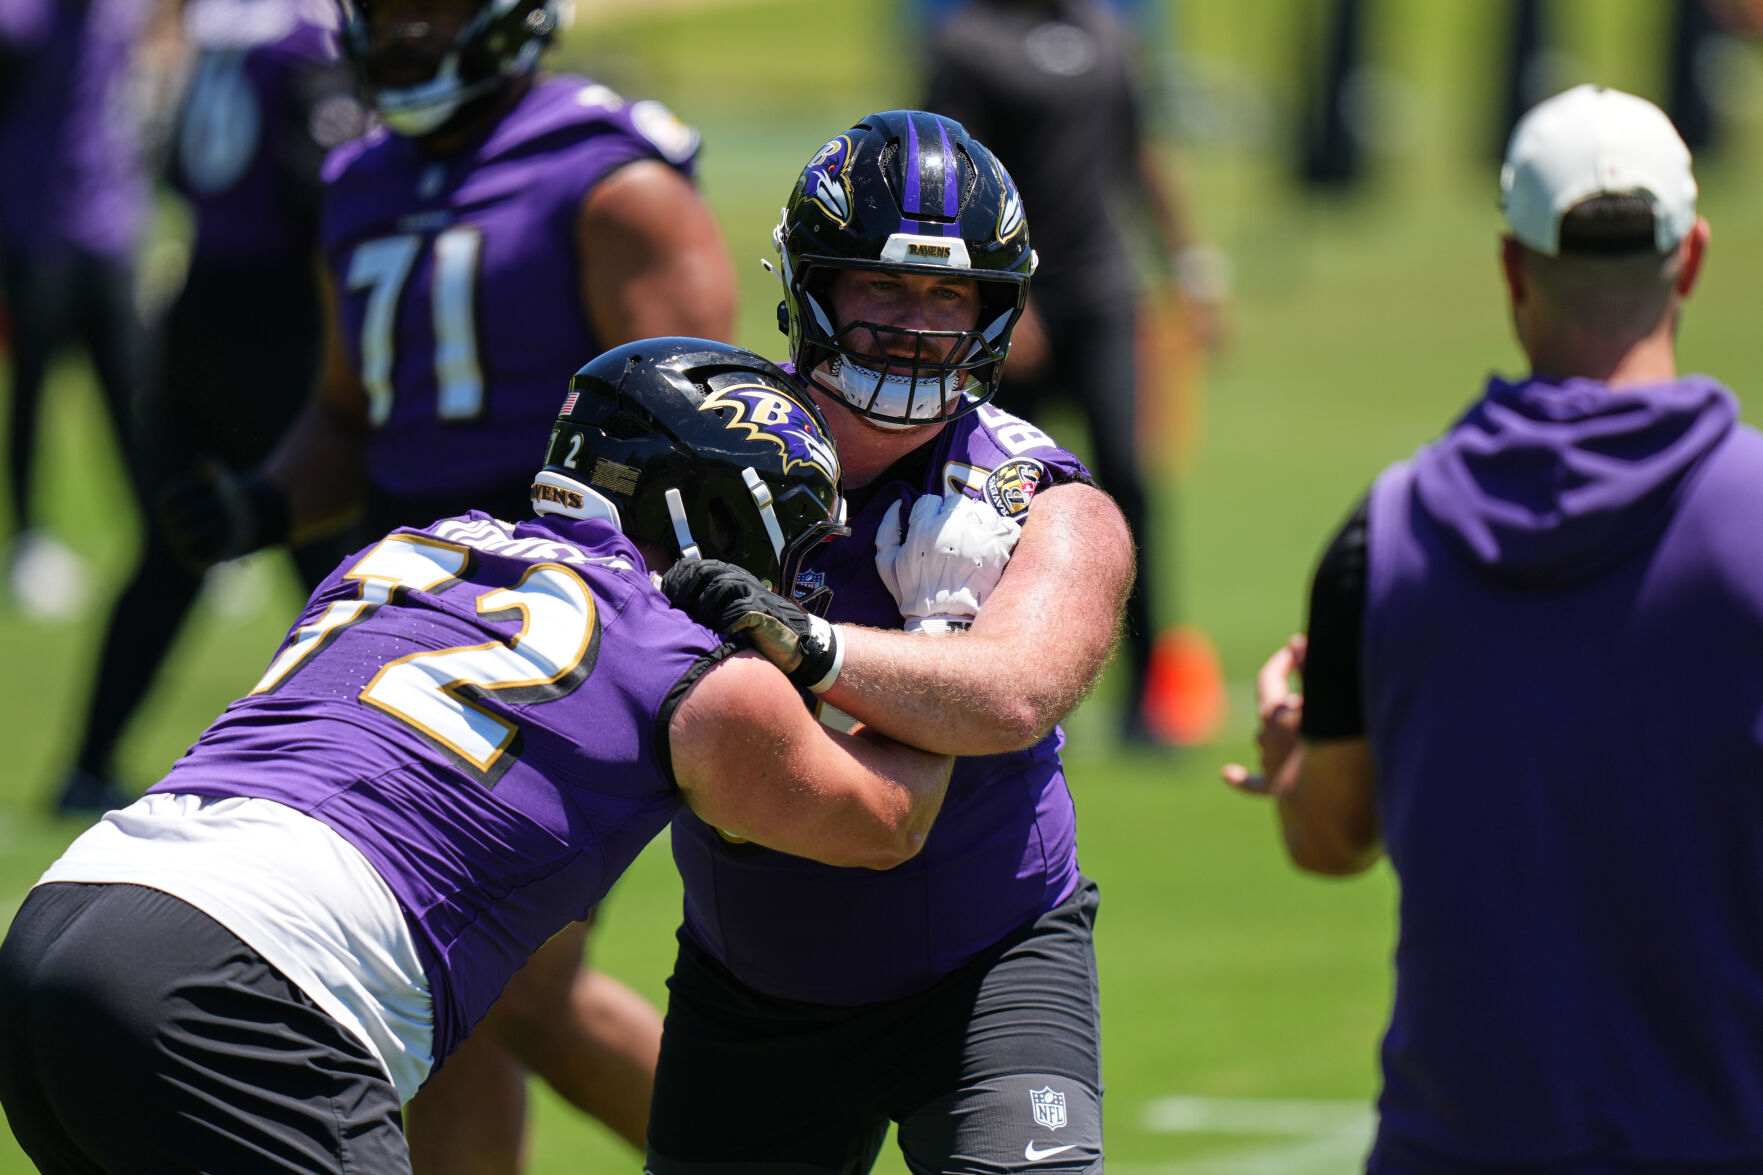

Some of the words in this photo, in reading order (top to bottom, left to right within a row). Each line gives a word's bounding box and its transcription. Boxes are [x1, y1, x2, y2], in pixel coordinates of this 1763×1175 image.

[908, 243, 951, 258] RAVENS
[346, 228, 484, 427] 71
[750, 397, 793, 426] B
[246, 533, 600, 778] 72
[1038, 1104, 1063, 1123] NFL
